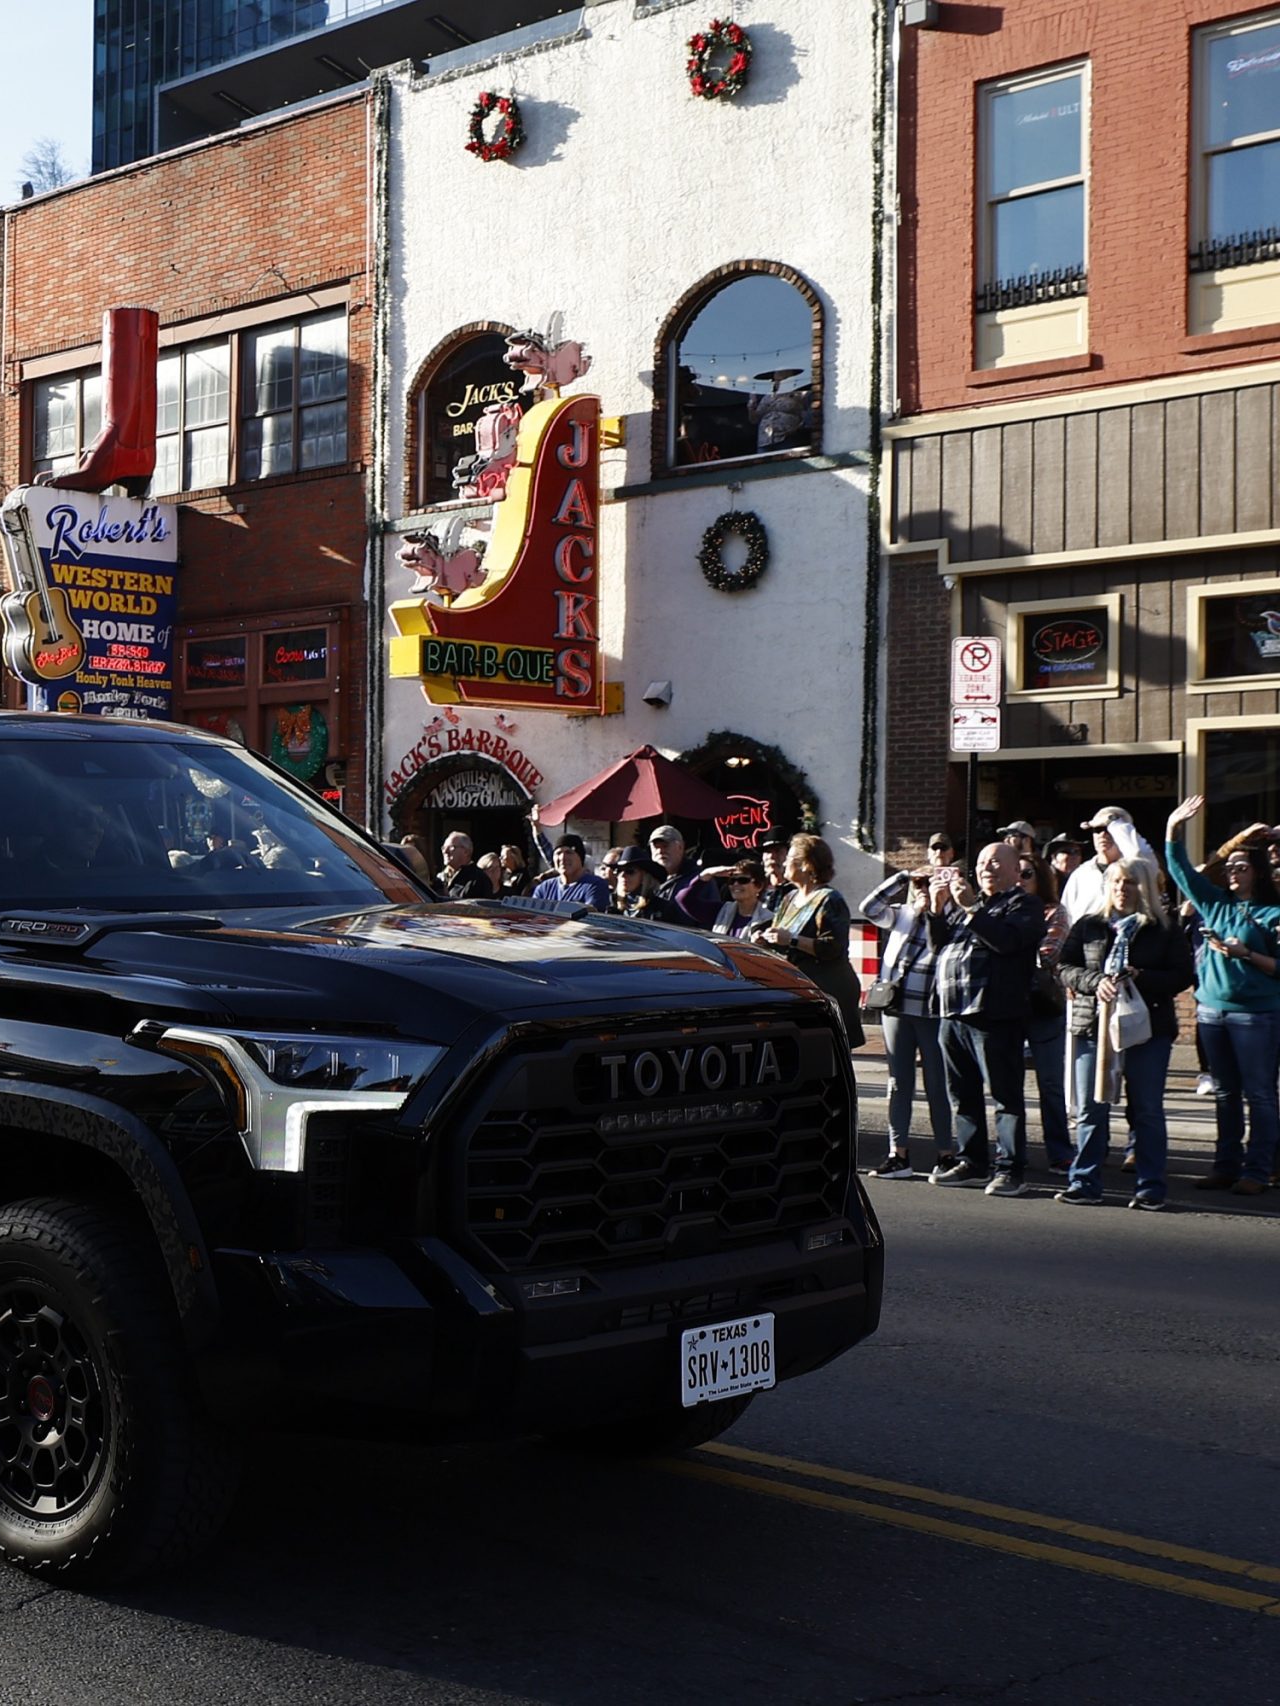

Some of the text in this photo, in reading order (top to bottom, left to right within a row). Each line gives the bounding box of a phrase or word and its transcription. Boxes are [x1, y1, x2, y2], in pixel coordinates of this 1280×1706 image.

[446, 381, 519, 417] JACK'S
[45, 504, 171, 561] Robert's
[551, 419, 600, 699] JACKS
[51, 563, 174, 595] WESTERN
[67, 588, 158, 616] WORLD
[82, 618, 173, 649] HOME of
[1038, 628, 1099, 653] STAGE
[425, 640, 555, 684] BAR-B-QUE
[76, 671, 173, 690] Honky Tonk Heaven
[384, 734, 442, 806] JACK'S
[458, 790, 490, 808] 1976
[7, 918, 80, 933] TRD PRO
[601, 1040, 782, 1099] TOYOTA
[712, 1323, 748, 1343] TEXAS
